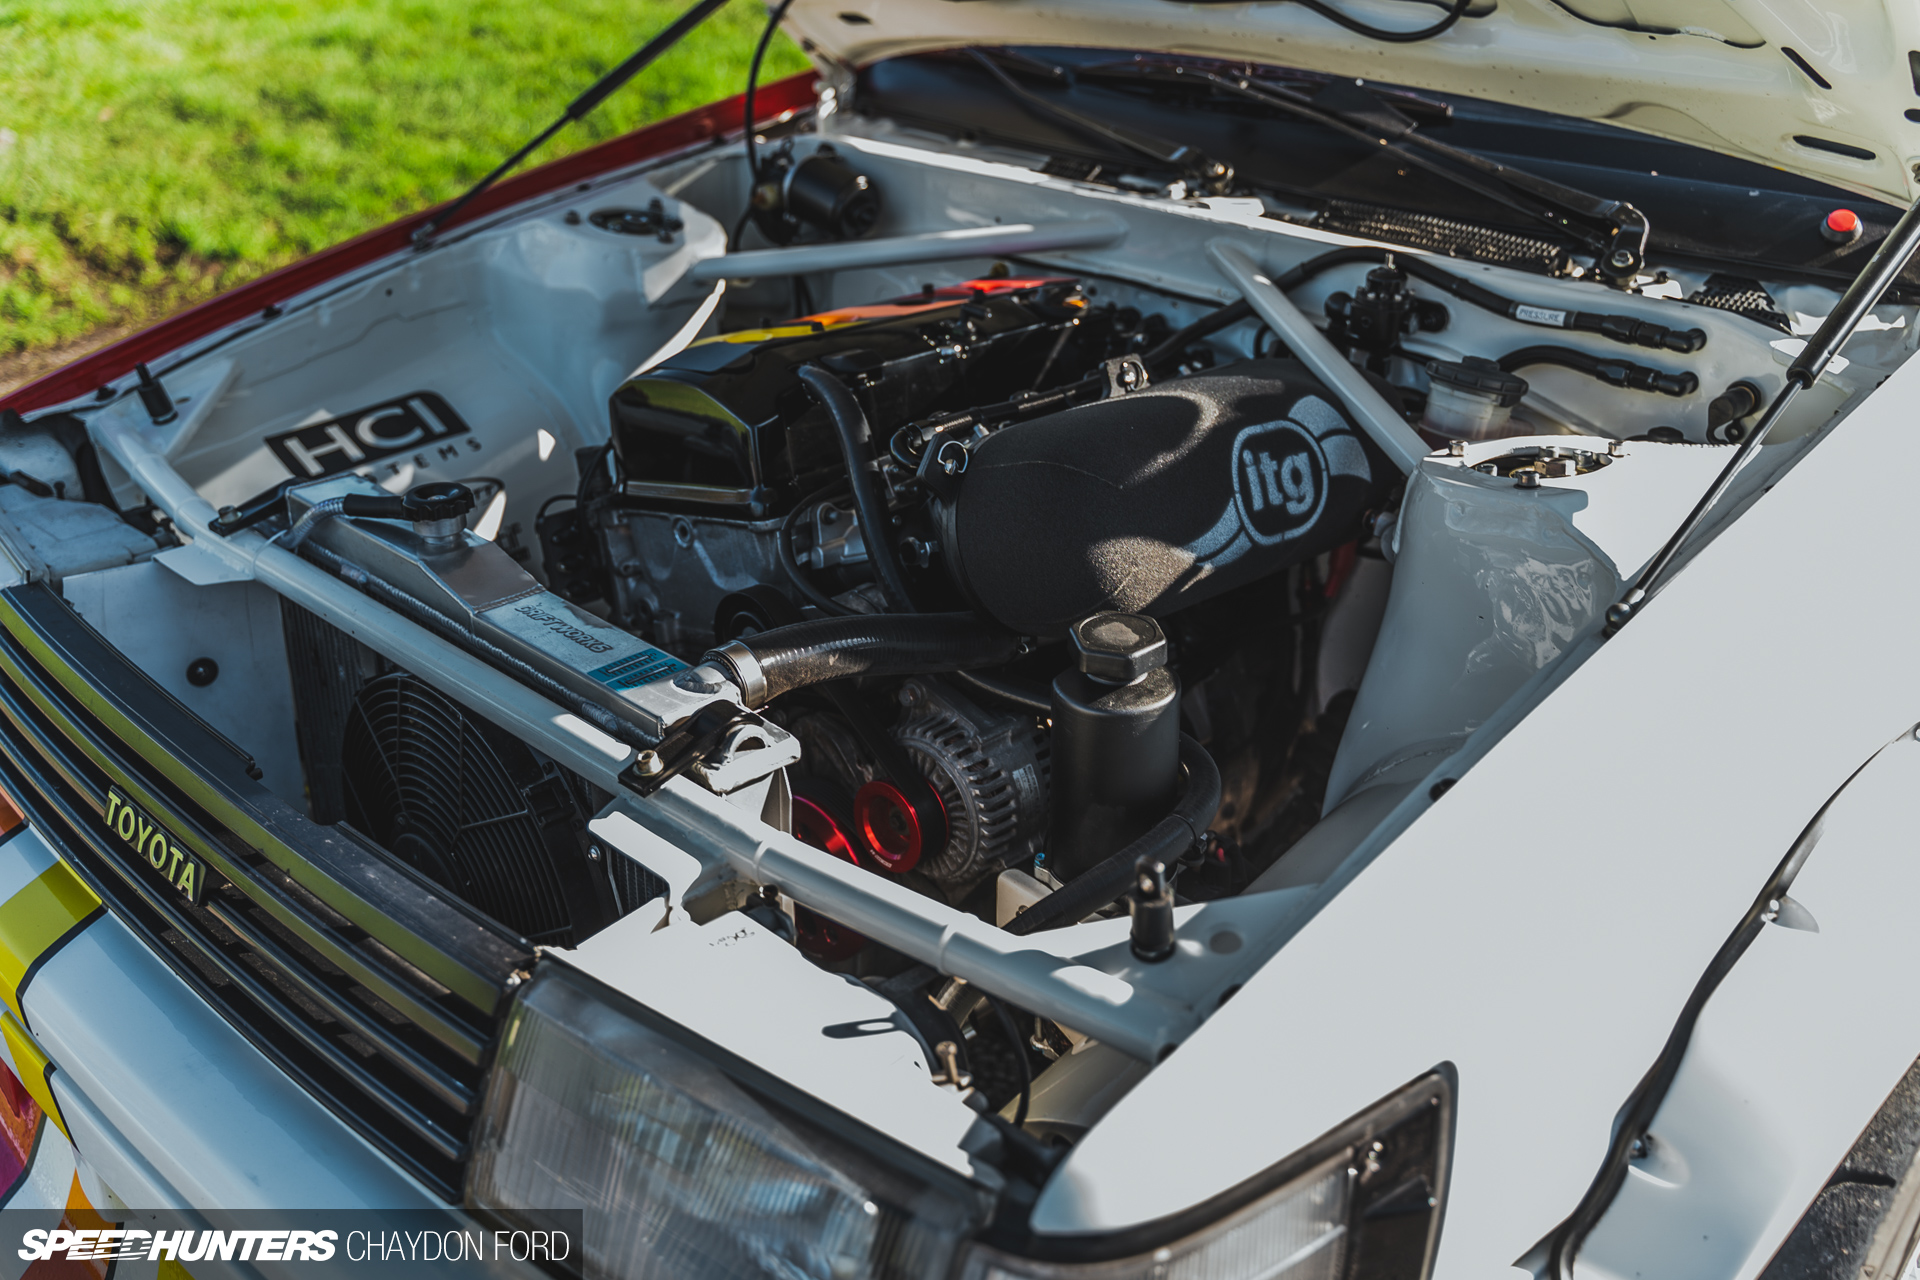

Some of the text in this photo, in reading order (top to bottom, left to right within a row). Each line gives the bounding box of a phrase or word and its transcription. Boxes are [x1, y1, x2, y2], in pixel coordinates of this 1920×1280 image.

[1518, 308, 1561, 323] PRESSURE
[283, 398, 448, 477] HCI
[1242, 449, 1315, 516] itg
[514, 605, 614, 654] DRIFTWORKS
[106, 789, 195, 902] TOYOTA
